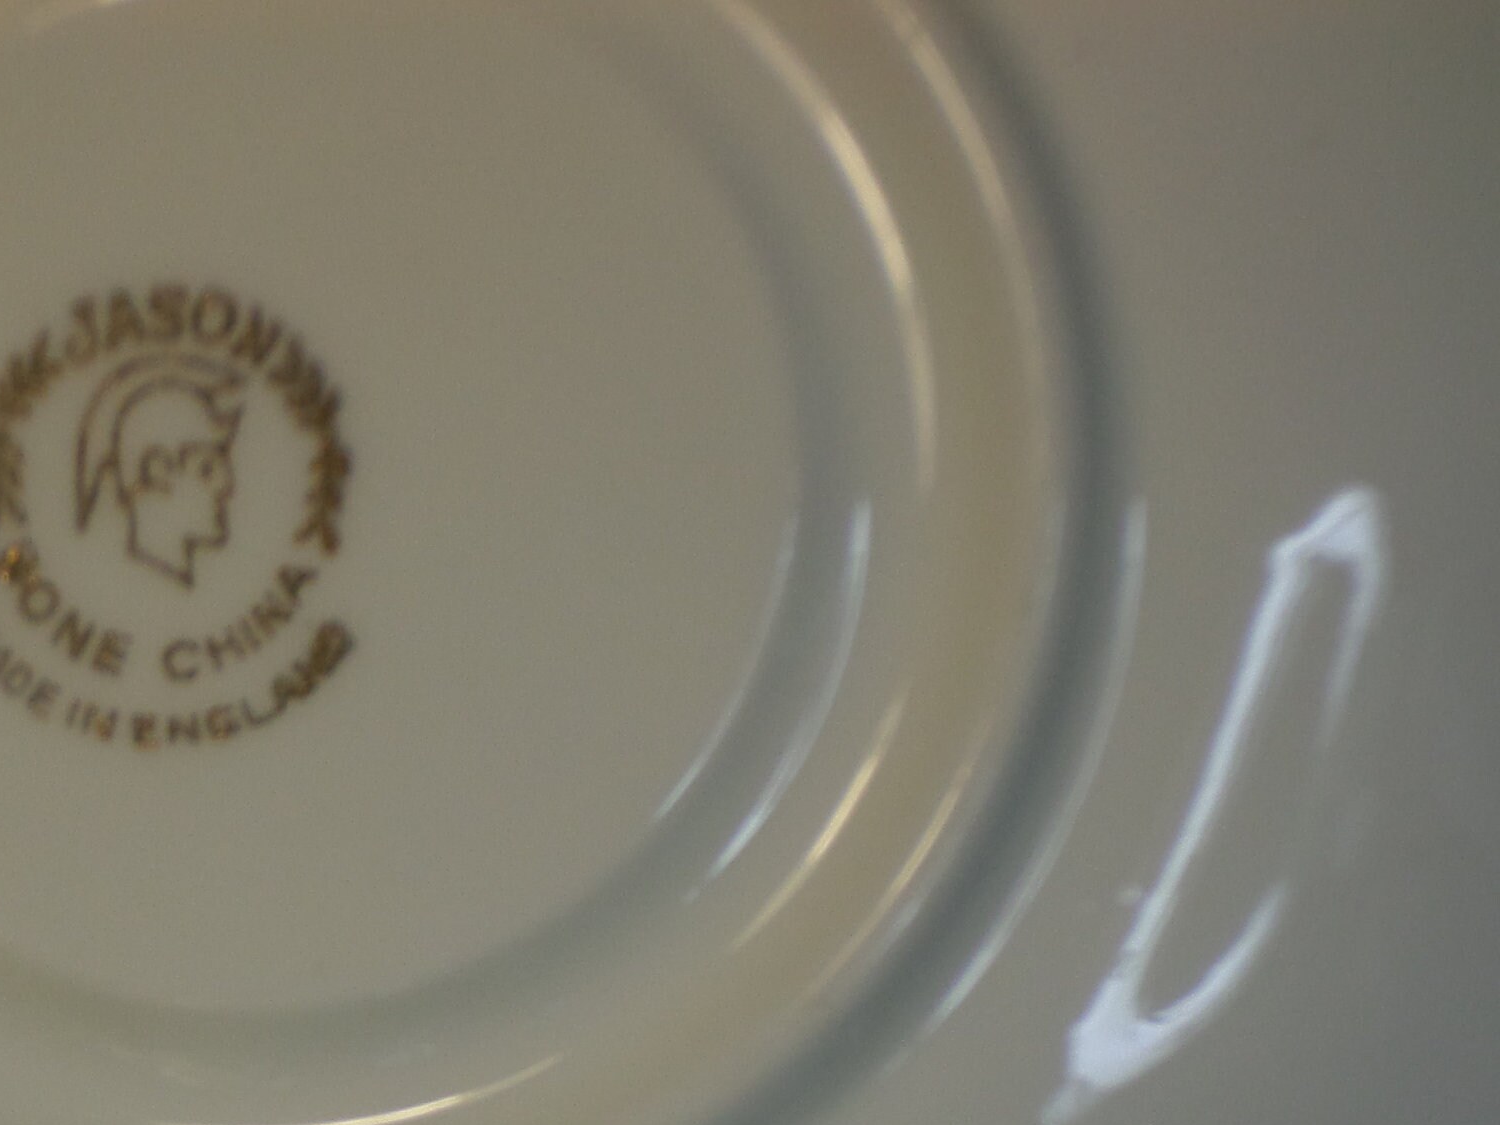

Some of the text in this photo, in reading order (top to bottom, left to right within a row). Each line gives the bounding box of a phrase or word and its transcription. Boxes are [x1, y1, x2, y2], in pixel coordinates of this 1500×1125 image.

[64, 280, 282, 363] JASON
[160, 563, 318, 682] CHINA
[66, 697, 119, 743] IN
[130, 617, 357, 751] ENGLAND
